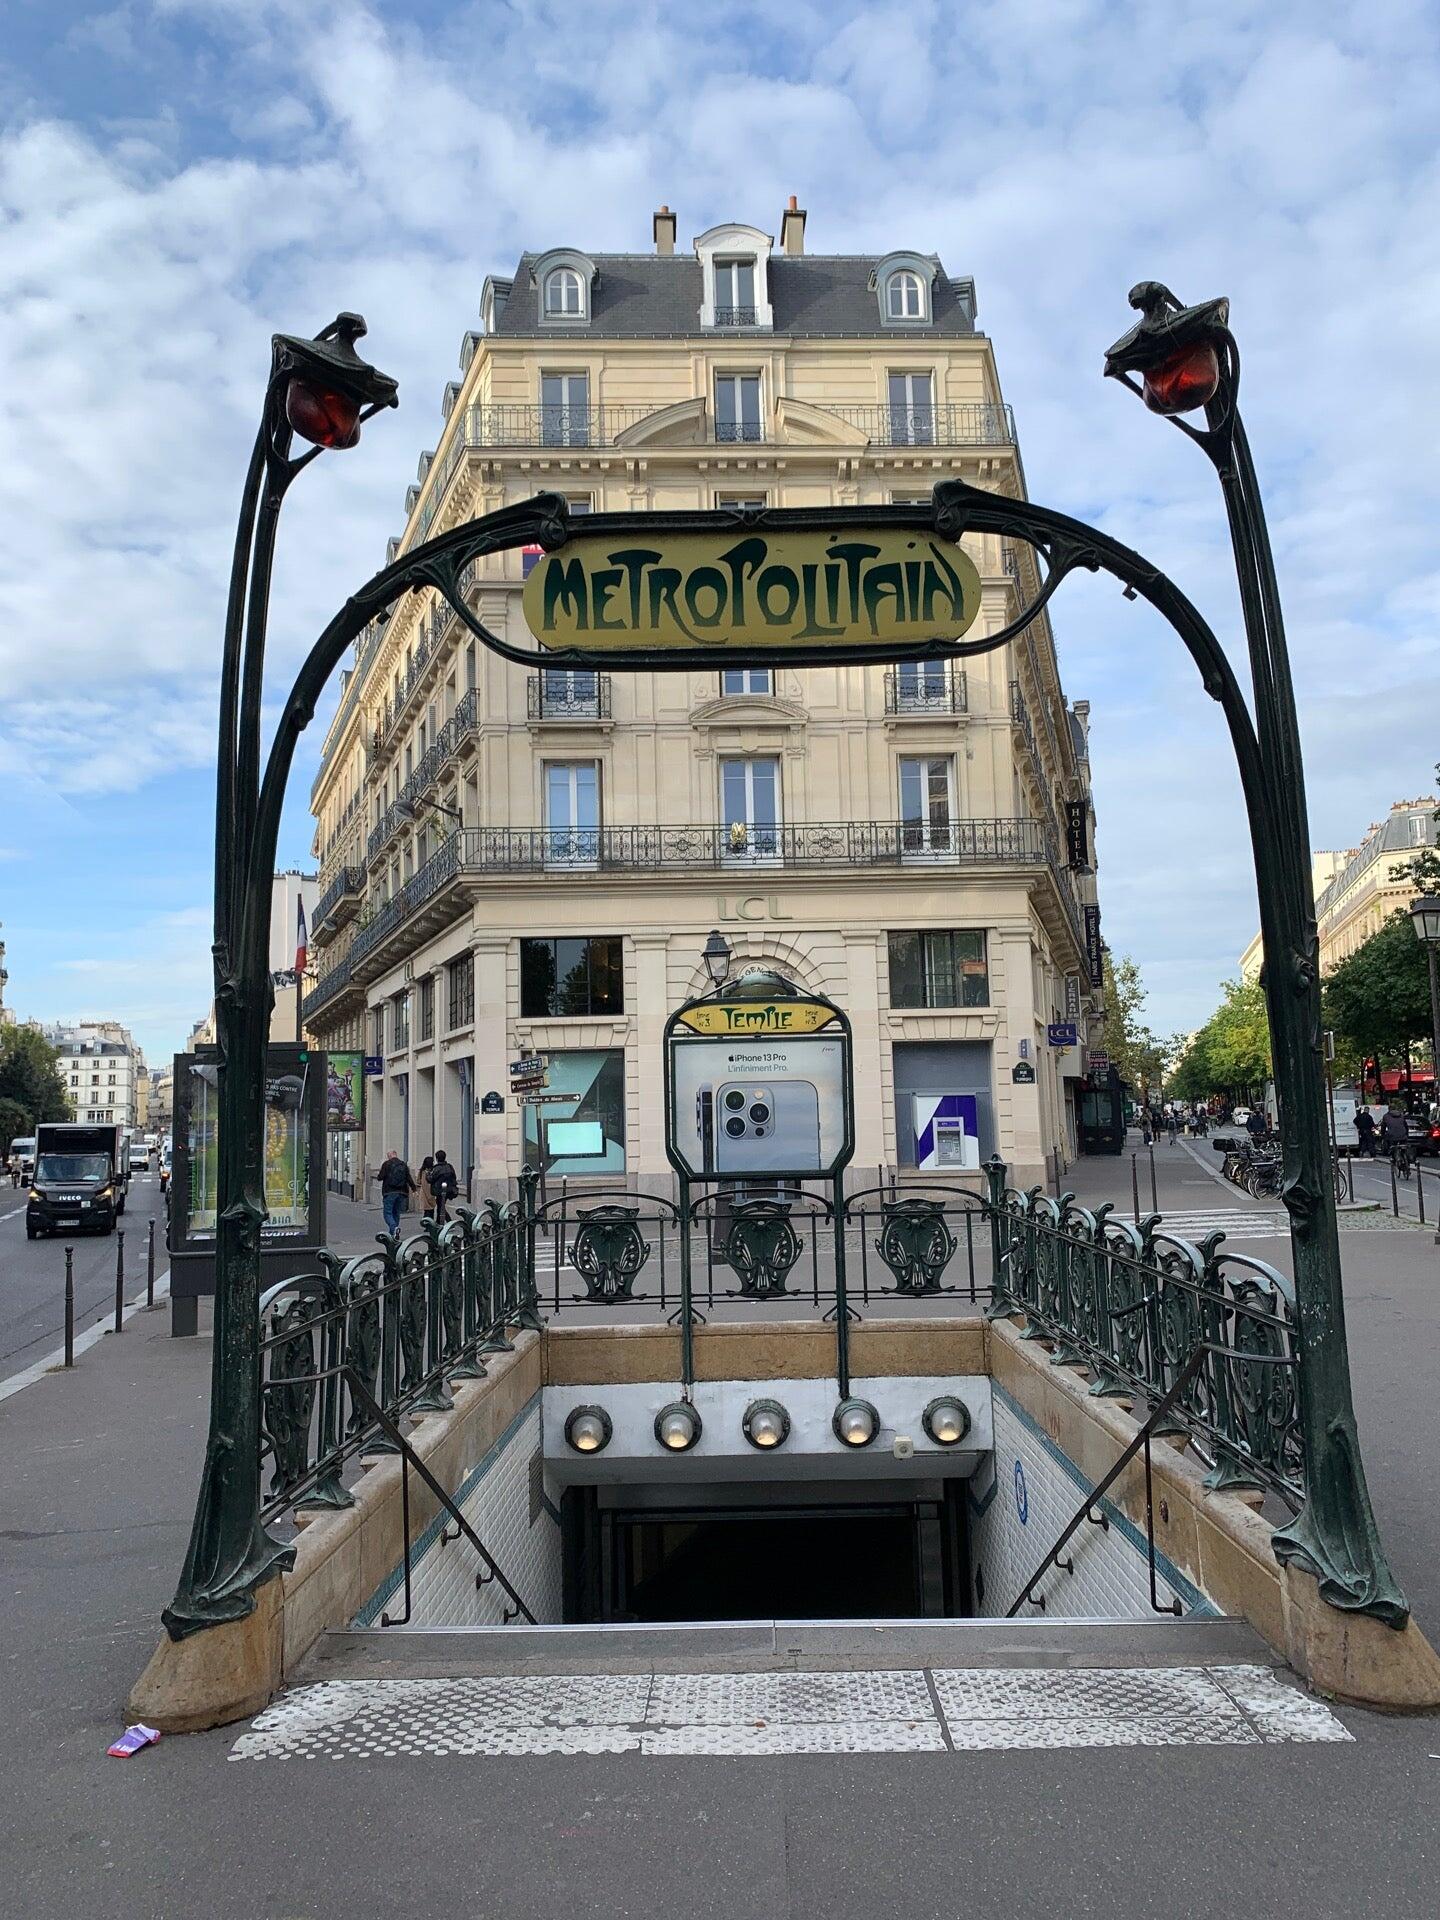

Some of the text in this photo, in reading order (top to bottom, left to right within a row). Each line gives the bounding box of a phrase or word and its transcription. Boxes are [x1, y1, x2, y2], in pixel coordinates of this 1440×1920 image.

[1072, 808, 1082, 860] HOTEL
[716, 896, 793, 921] LCL
[719, 1005, 793, 1030] TEMPLE
[1050, 1029, 1073, 1037] LCL
[735, 1053, 787, 1062] iPhone 13 Pro
[728, 1063, 789, 1073] L'infiniment Pro.
